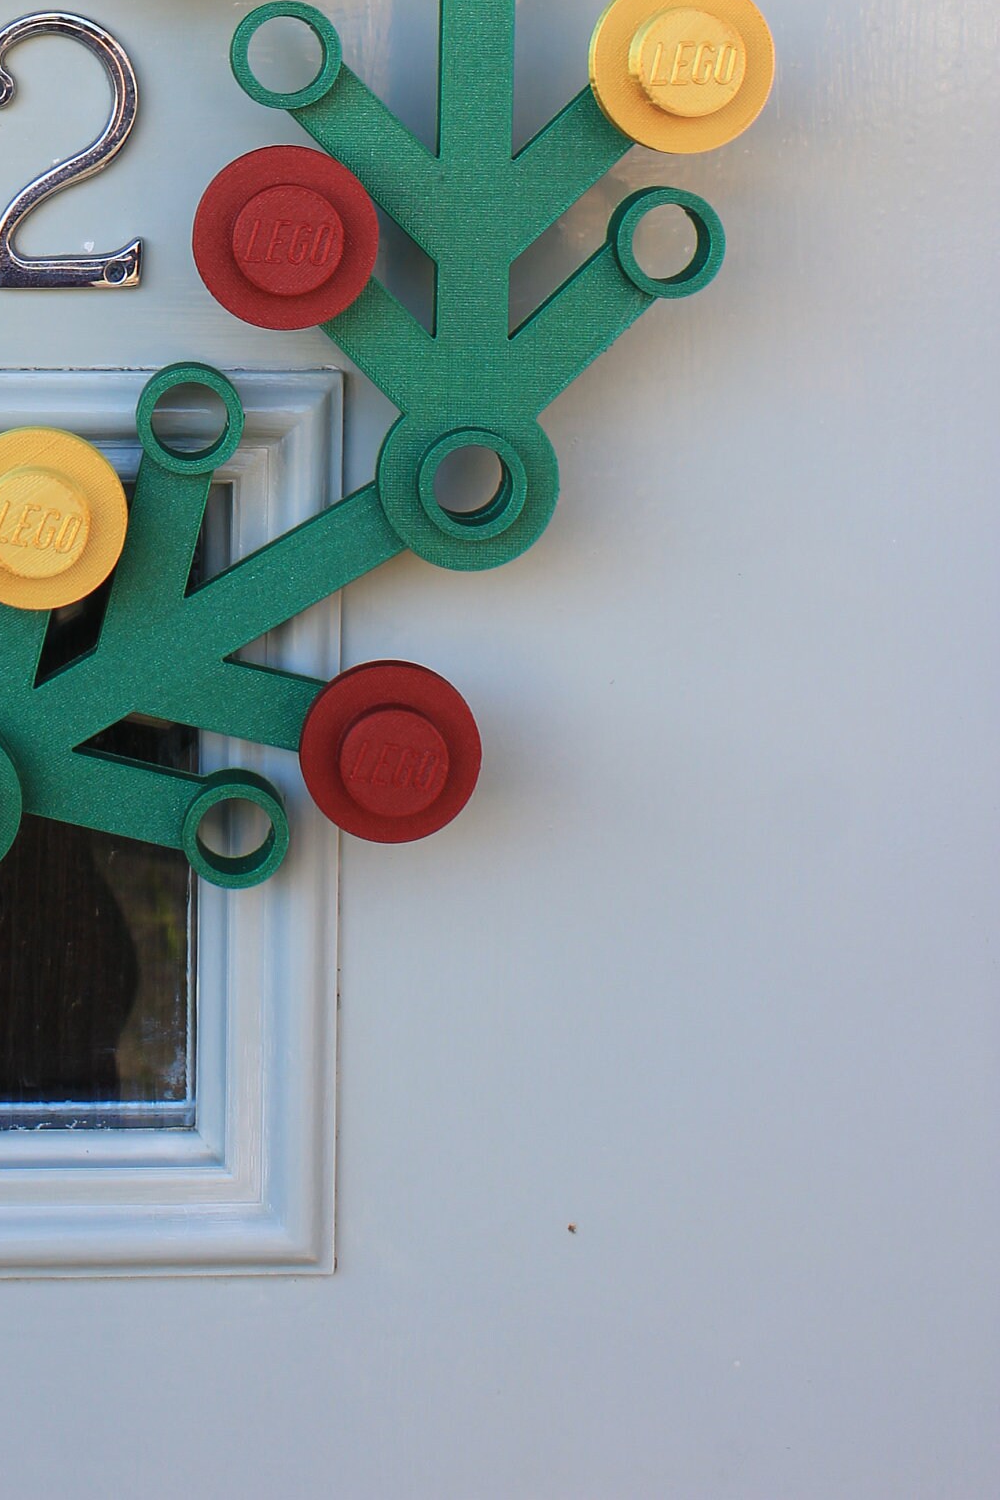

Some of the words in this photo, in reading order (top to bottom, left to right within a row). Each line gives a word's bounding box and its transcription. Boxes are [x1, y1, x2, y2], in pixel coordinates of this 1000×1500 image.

[650, 41, 736, 86] LEGO
[244, 222, 334, 266] LEGO
[349, 741, 441, 788] LEGO
